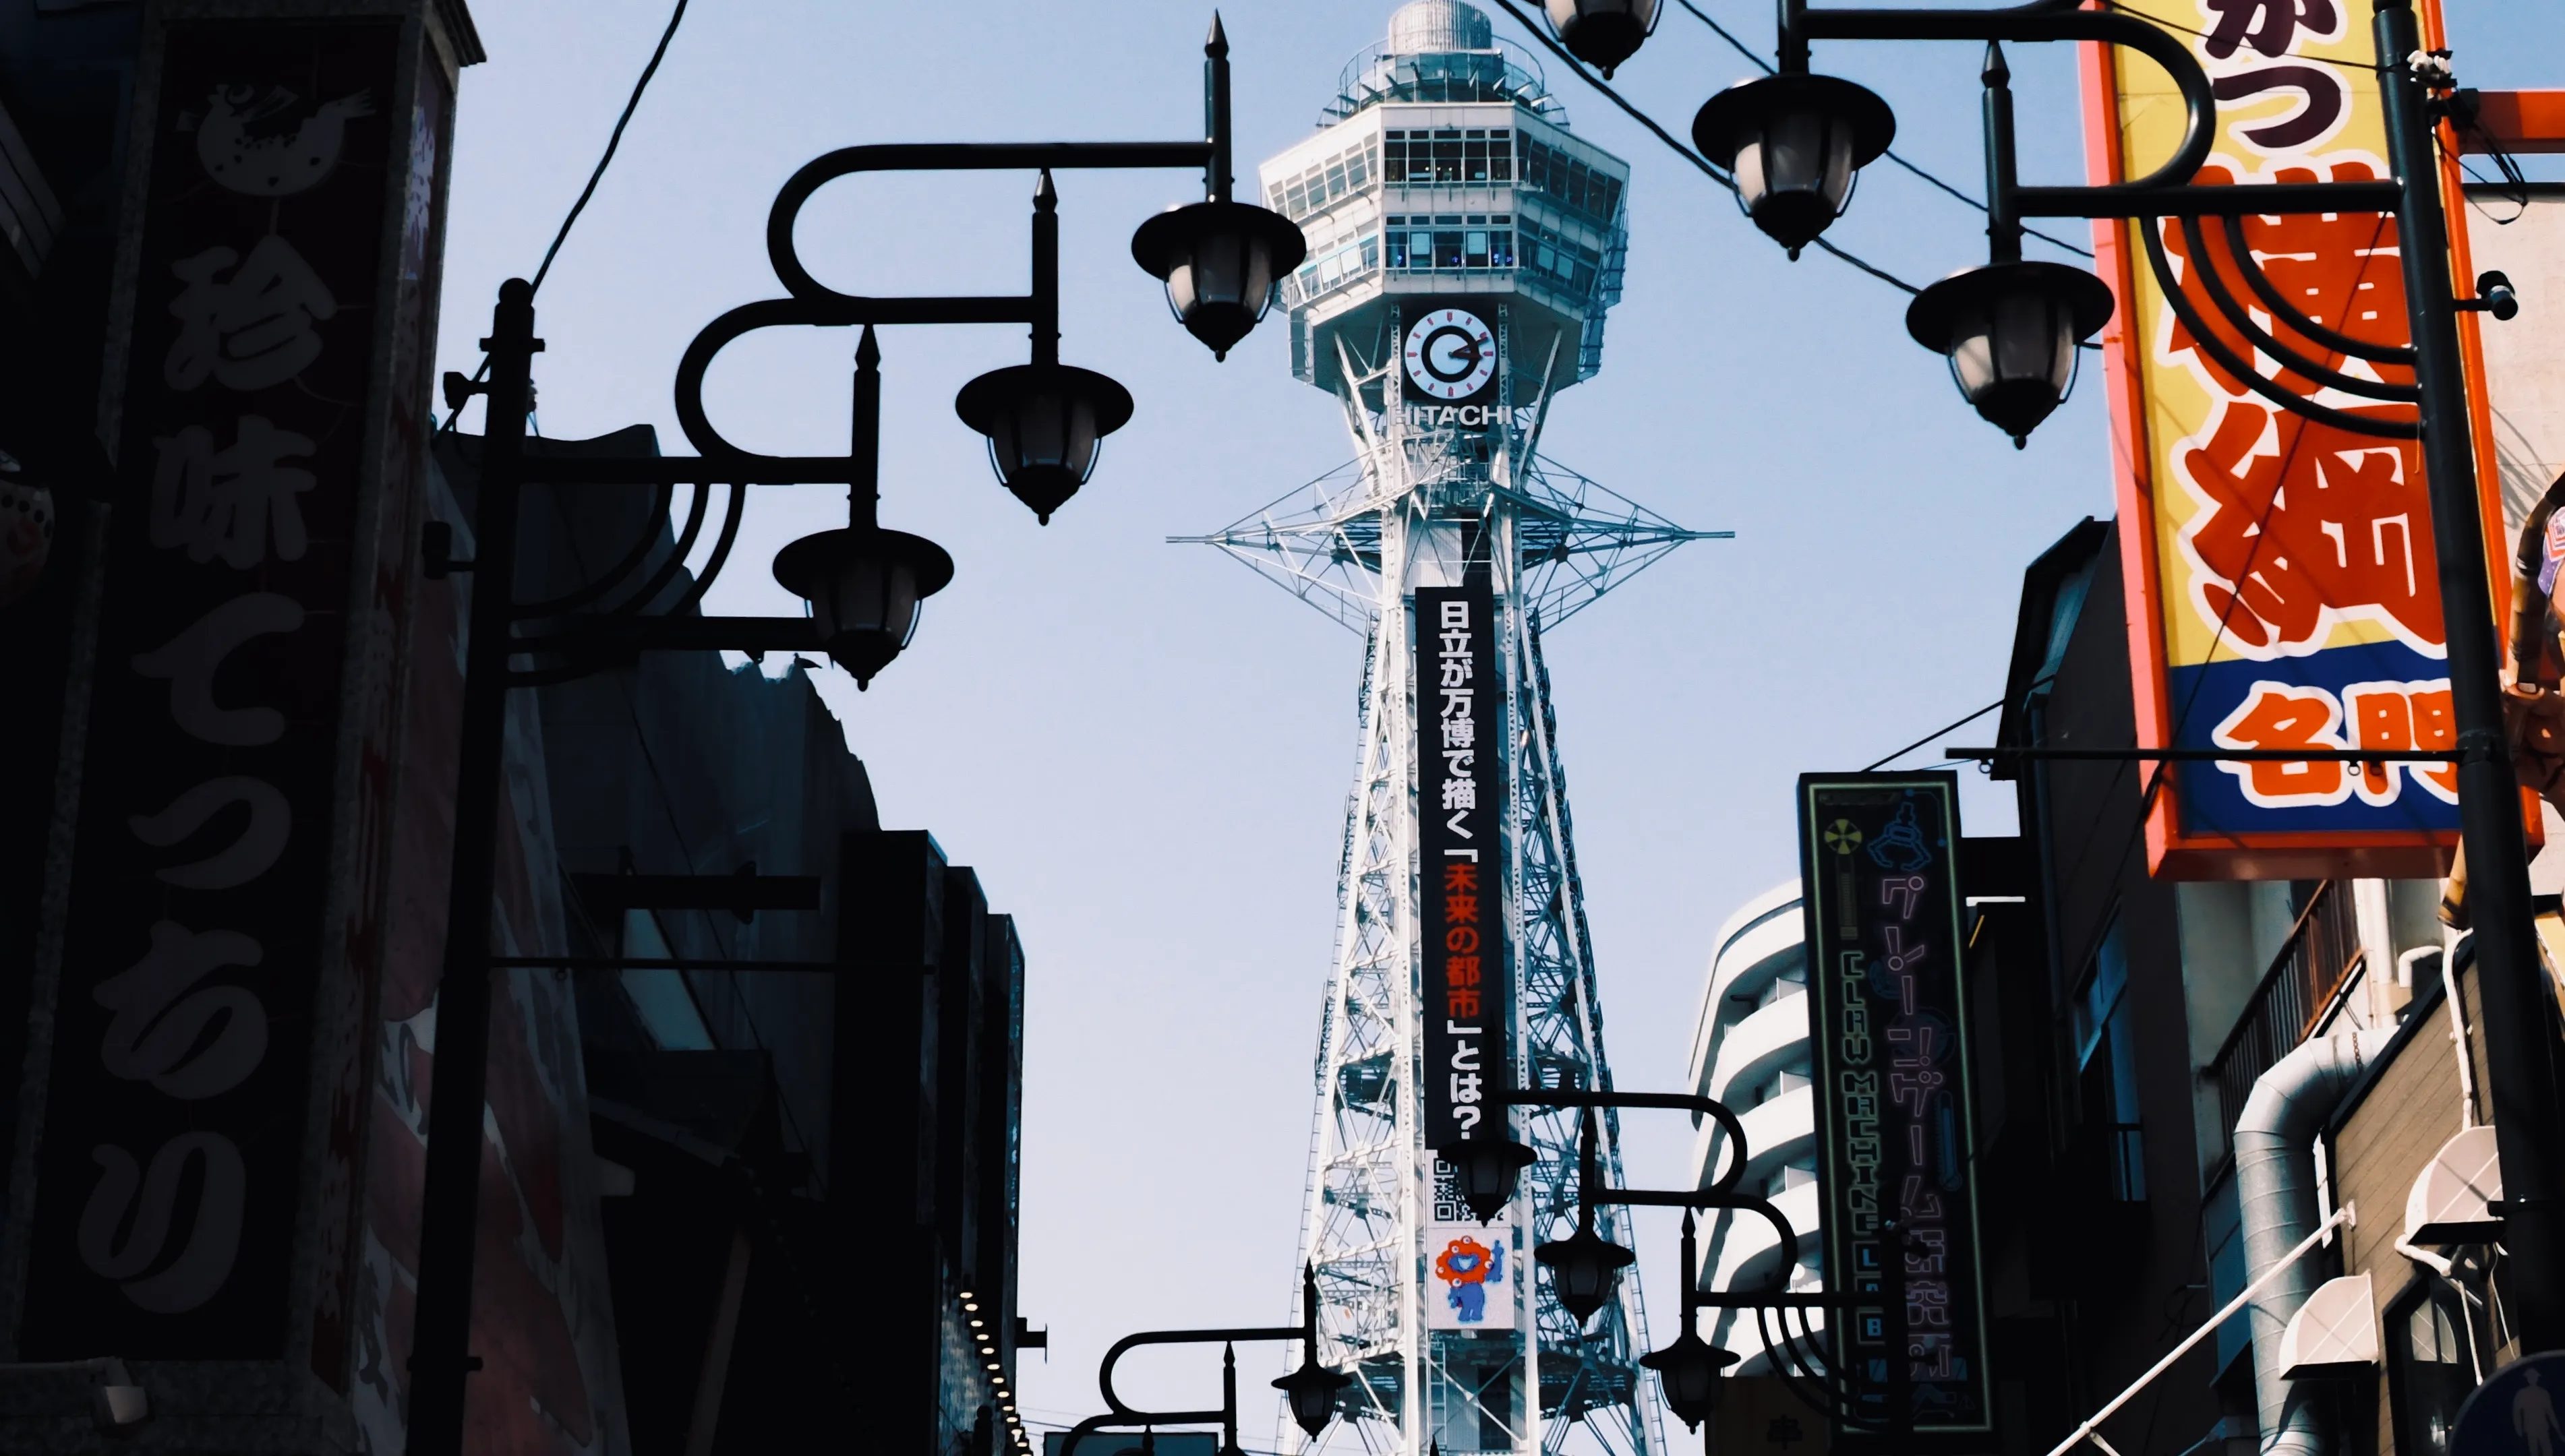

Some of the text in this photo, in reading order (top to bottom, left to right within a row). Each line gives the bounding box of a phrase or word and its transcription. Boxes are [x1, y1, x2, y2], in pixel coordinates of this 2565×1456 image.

[1390, 405, 1512, 426] HITACHI
[1438, 601, 1483, 1139] 日立が万博で描く「未来の都市」とは?
[1841, 951, 1871, 1064] CLAW
[1841, 1070, 1881, 1236] MACHINE
